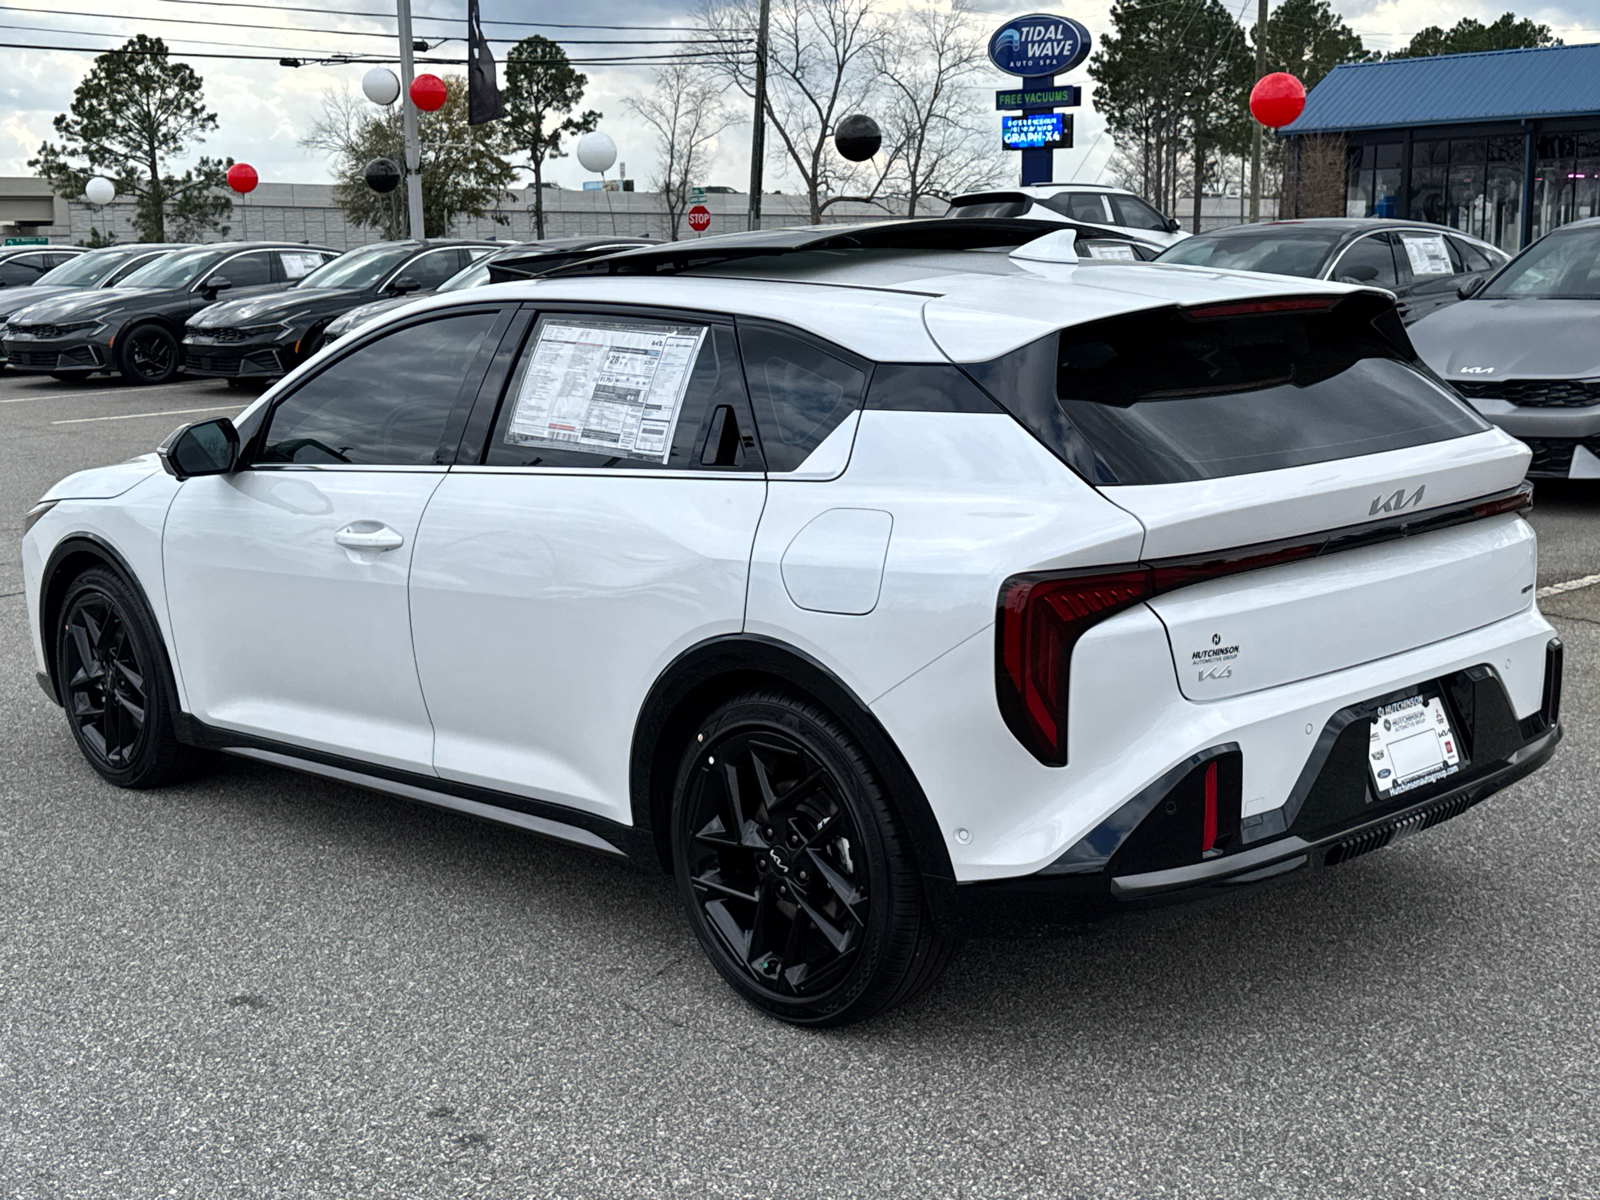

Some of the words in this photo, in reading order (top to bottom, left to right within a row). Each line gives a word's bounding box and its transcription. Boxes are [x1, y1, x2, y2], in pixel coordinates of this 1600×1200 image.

[1021, 25, 1064, 42] TIDAL
[1027, 40, 1073, 58] WAVE
[999, 93, 1023, 105] FREE
[1024, 90, 1068, 103] VACUUMS
[689, 213, 710, 224] STOP
[1460, 366, 1495, 374] KIA
[1368, 484, 1426, 516] KIA
[1192, 645, 1240, 660] HUTCHINSON
[1198, 664, 1232, 682] K4
[1384, 694, 1424, 715] HUTCHINSON
